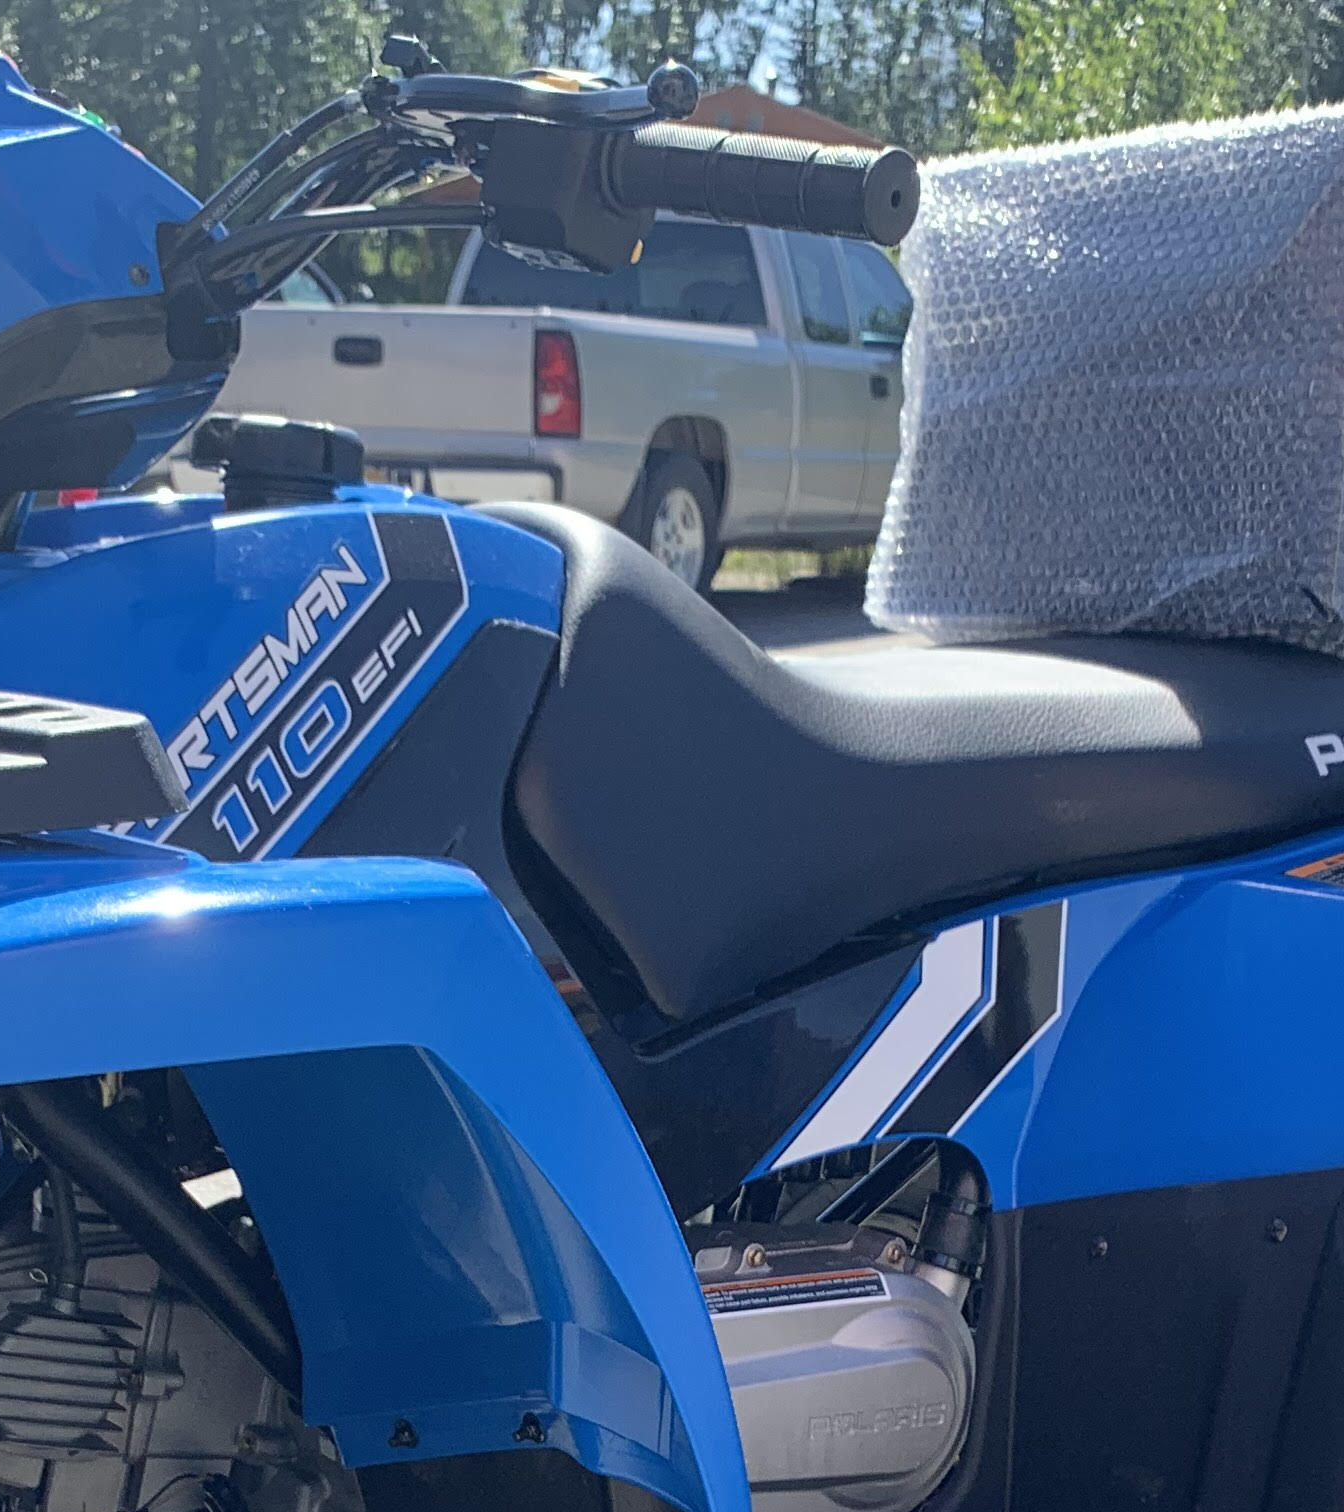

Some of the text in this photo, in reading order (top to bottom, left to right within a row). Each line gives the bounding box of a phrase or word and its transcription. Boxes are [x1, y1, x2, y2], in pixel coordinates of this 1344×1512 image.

[167, 544, 368, 790] RTSMAN
[212, 606, 424, 854] 110 EFI
[808, 1402, 947, 1440] POLARIS
